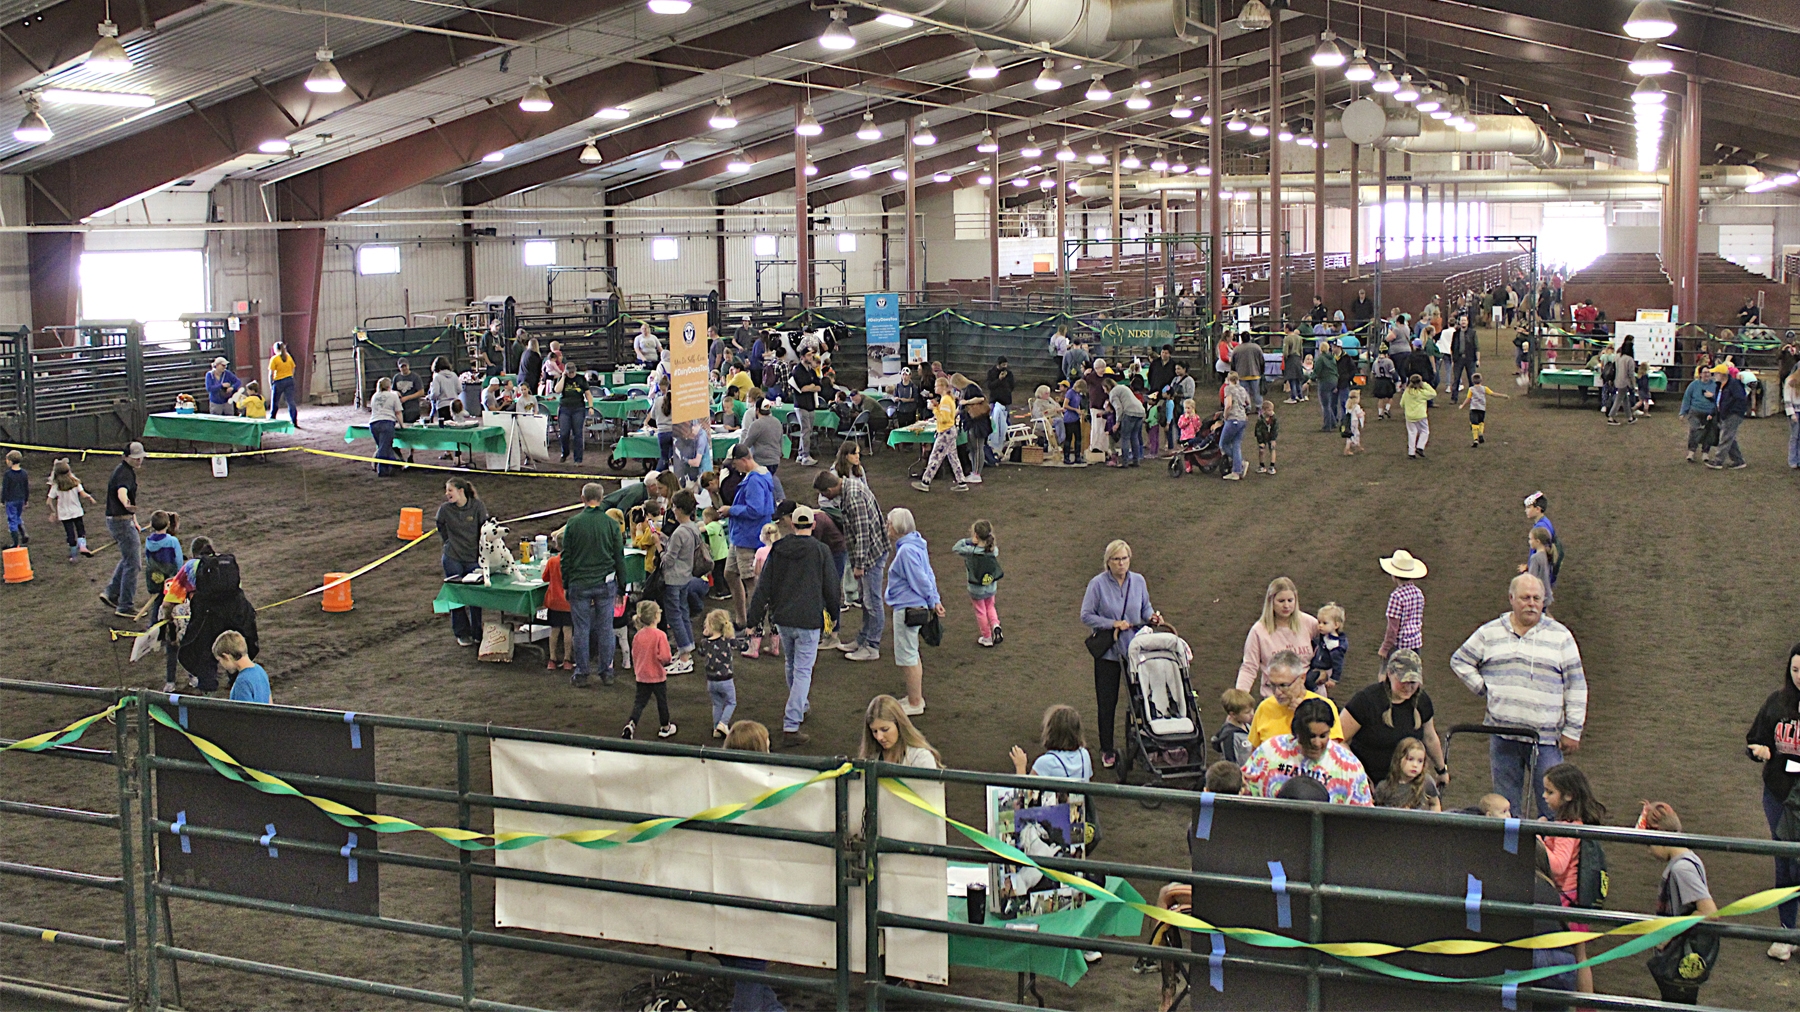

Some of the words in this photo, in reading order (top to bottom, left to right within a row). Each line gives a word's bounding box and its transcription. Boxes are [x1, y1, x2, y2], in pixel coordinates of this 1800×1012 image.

[1128, 329, 1154, 338] NDSU
[1379, 366, 1386, 377] 9
[1277, 763, 1332, 785] #FAMILY
